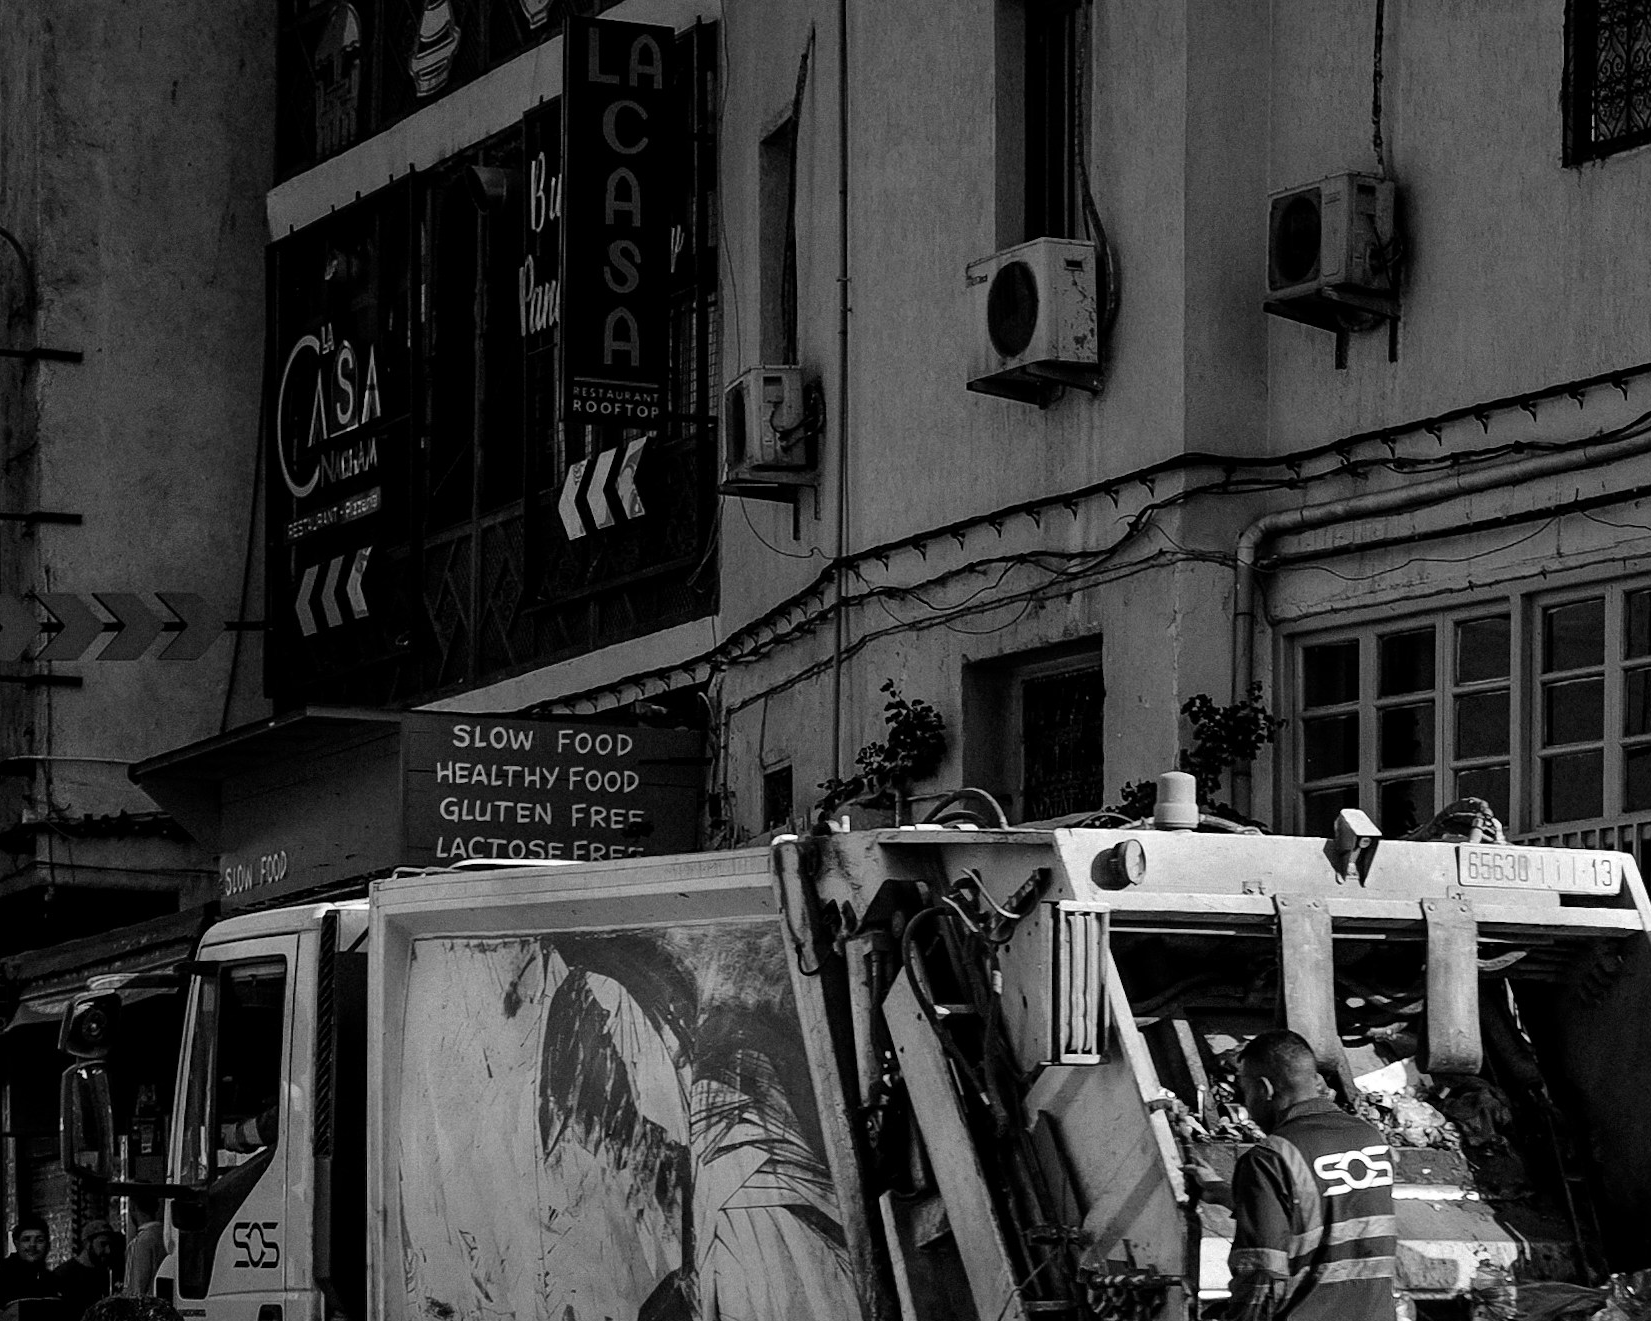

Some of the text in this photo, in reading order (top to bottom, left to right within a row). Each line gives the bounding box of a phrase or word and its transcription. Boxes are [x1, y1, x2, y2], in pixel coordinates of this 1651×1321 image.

[588, 27, 663, 367] LA CASA
[572, 386, 660, 403] RESTAURANT
[572, 399, 660, 419] ROOFTOP
[452, 724, 633, 757] SLOW FOOD
[436, 760, 639, 793] HEALTHY FOOD
[439, 797, 645, 829] GLUTEN FREE
[436, 836, 565, 860] LACTOSE
[224, 850, 287, 896] SLOW FOOD
[1314, 1145, 1394, 1197] SOS
[233, 1222, 280, 1269] SOS
